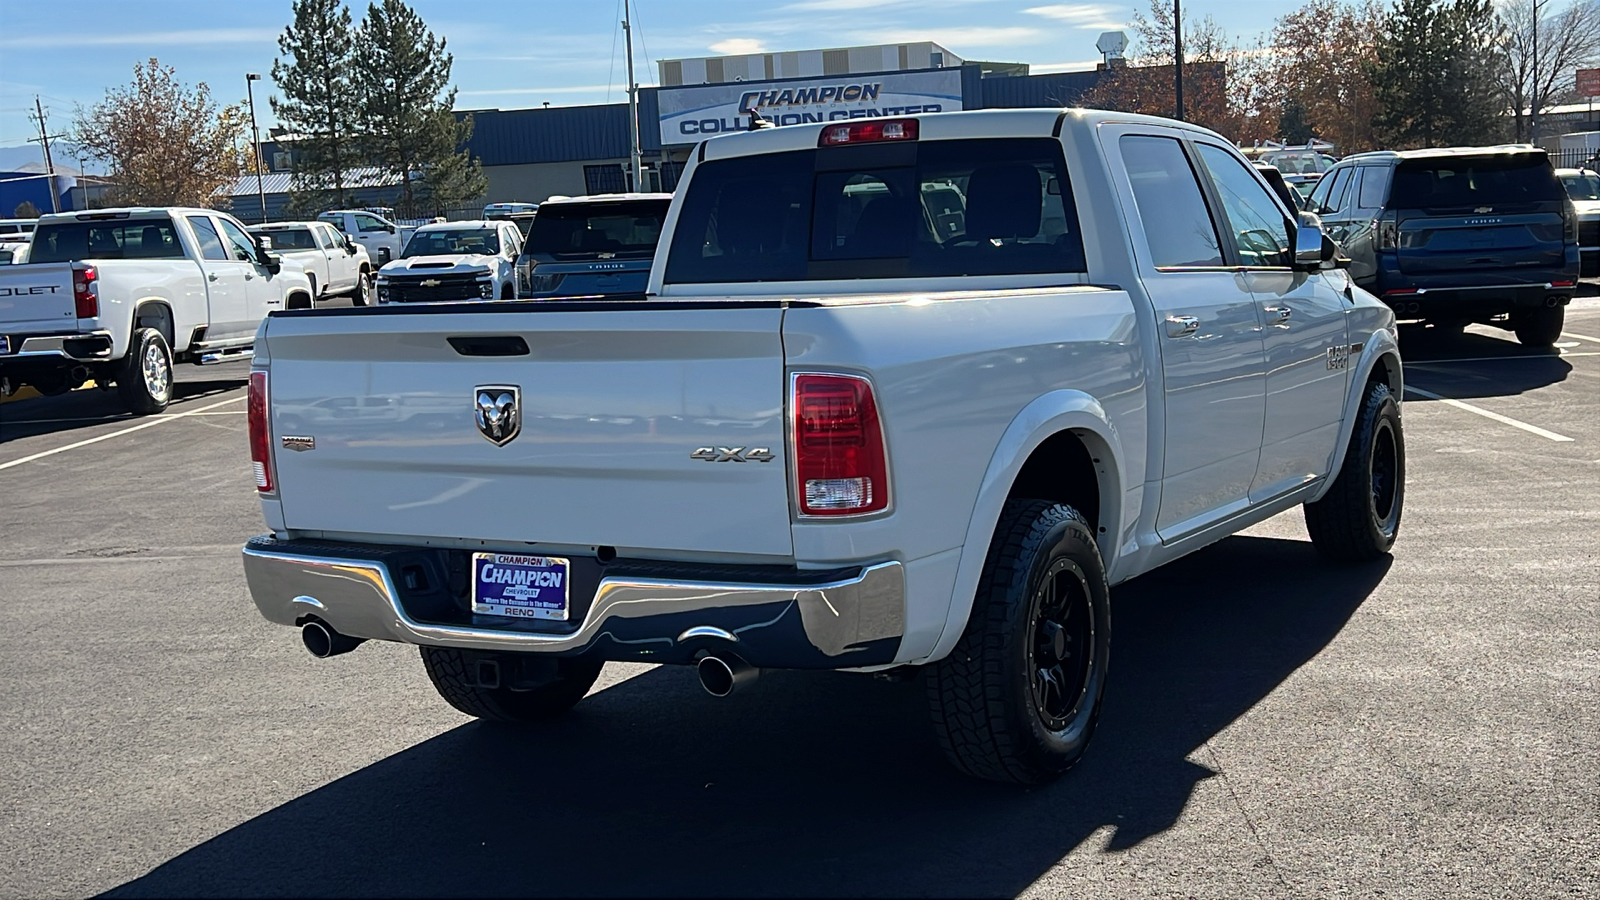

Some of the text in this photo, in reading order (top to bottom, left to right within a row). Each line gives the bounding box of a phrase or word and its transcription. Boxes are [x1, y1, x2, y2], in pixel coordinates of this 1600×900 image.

[738, 83, 882, 115] CHAMPION
[498, 555, 543, 566] CHAMPION
[480, 563, 562, 588] CHAMPION
[505, 588, 538, 597] CHEVROLET
[505, 607, 535, 617] RENO
